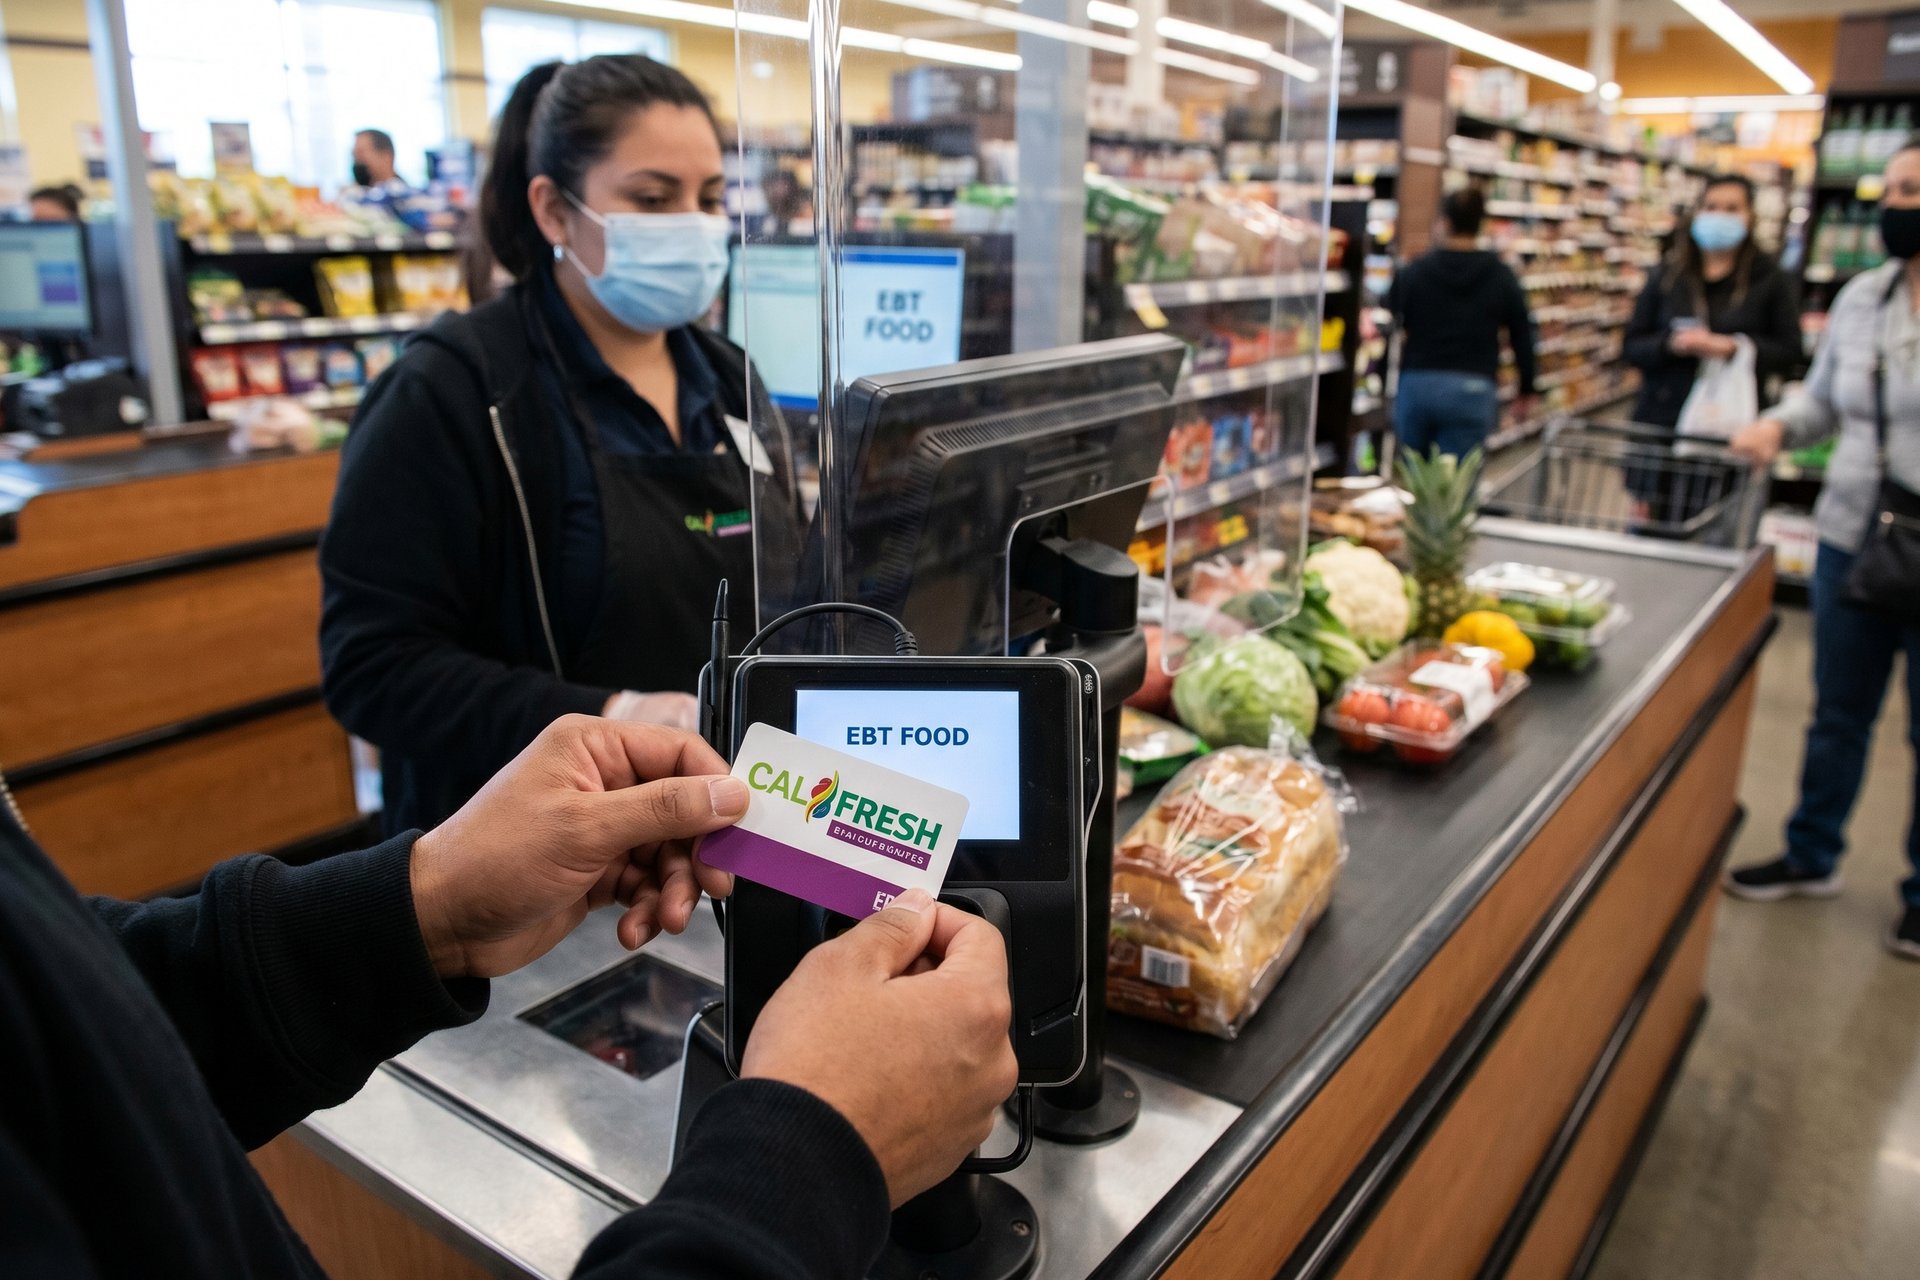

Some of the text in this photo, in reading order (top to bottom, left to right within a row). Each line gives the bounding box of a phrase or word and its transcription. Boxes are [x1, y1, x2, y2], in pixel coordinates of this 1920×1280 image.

[877, 289, 922, 313] EBT
[865, 318, 933, 342] FOOD
[847, 726, 969, 747] EBT FOOD
[748, 761, 942, 851] CAL FRESH
